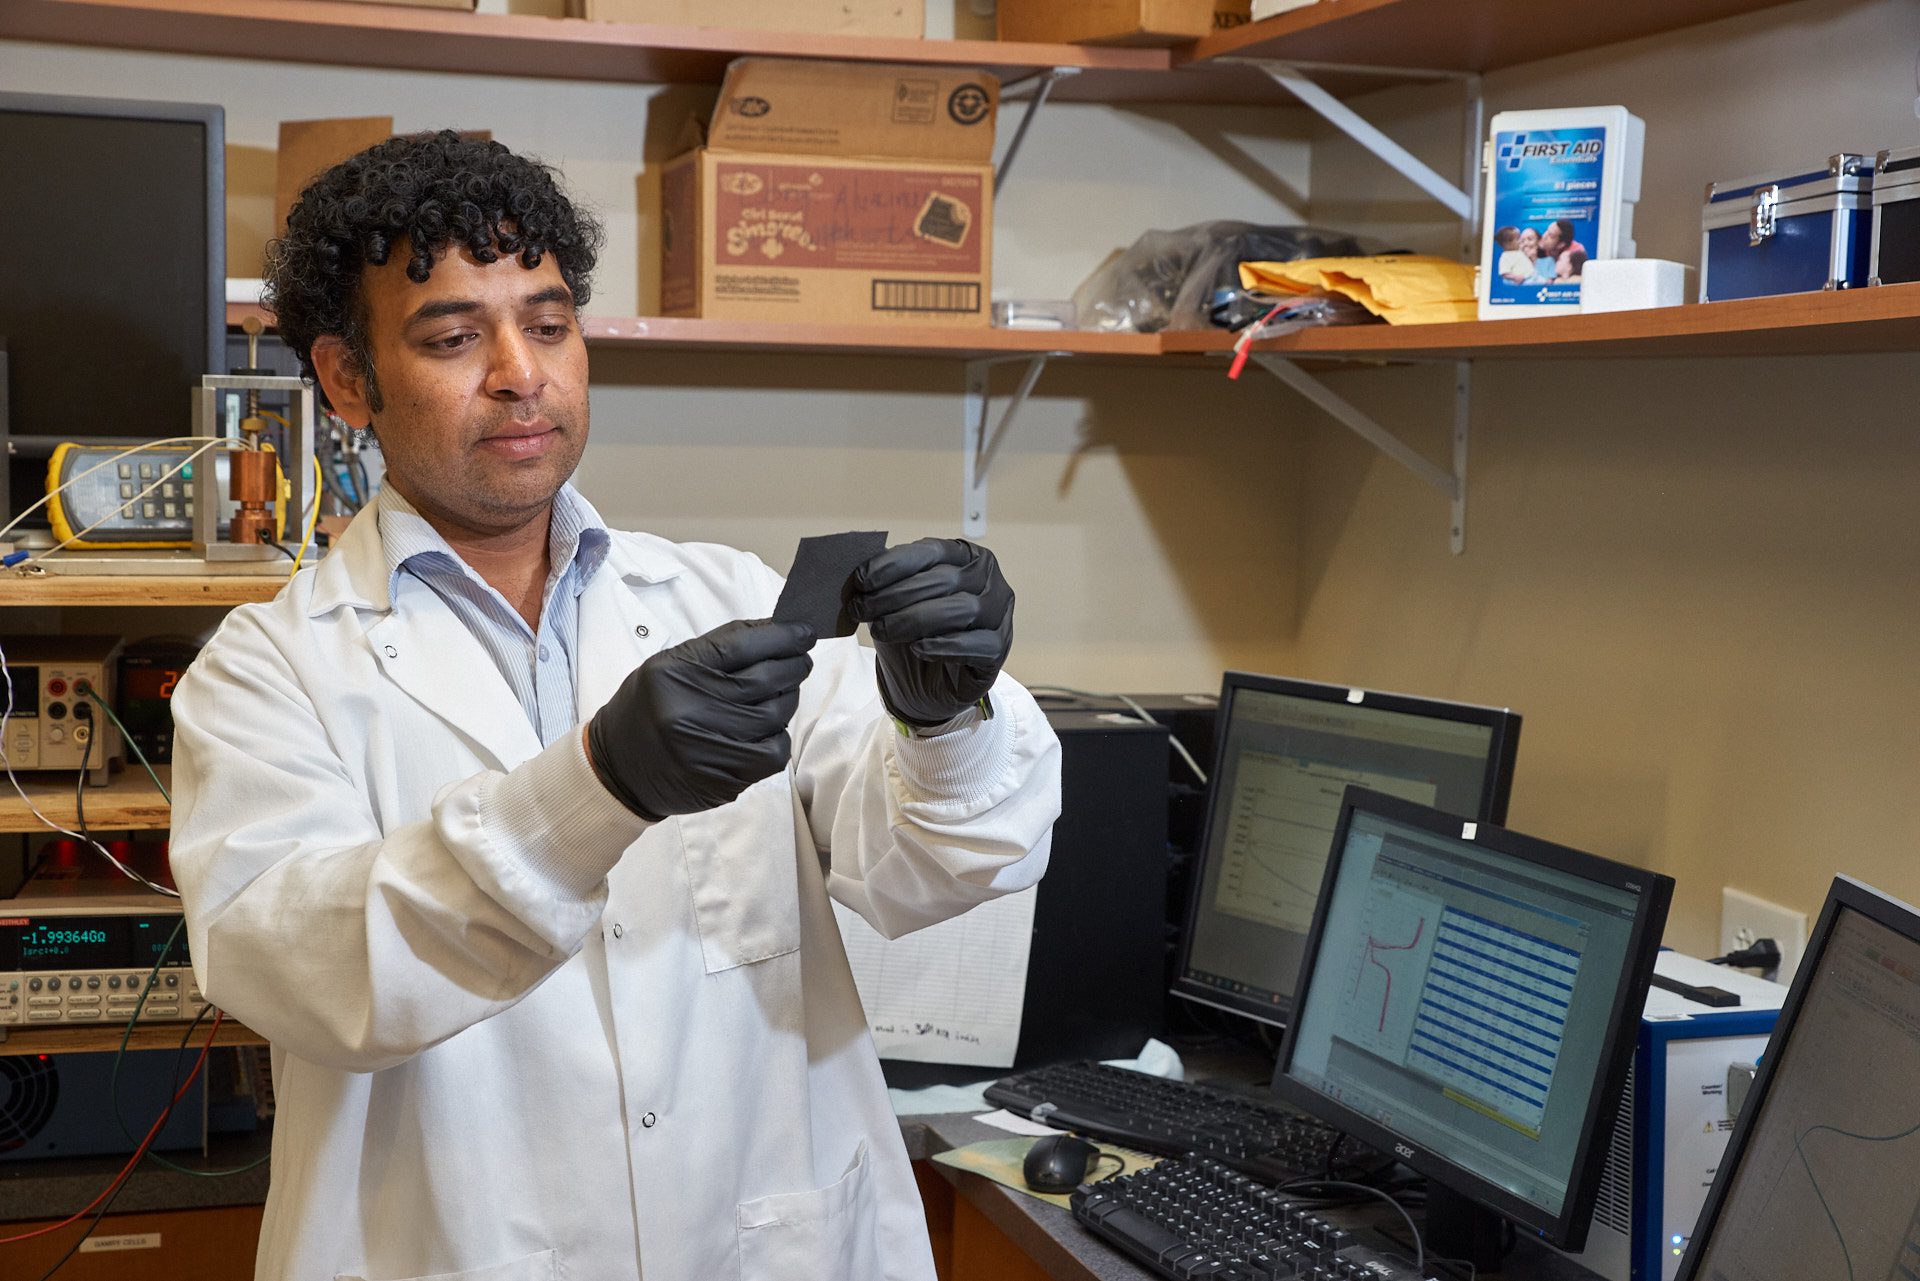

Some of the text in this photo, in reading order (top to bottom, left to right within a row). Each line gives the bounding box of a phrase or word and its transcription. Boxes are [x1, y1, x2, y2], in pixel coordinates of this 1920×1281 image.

[1523, 141, 1601, 156] FIRST AID
[1395, 1142, 1415, 1159] acer
[1365, 1261, 1393, 1276] DELL
